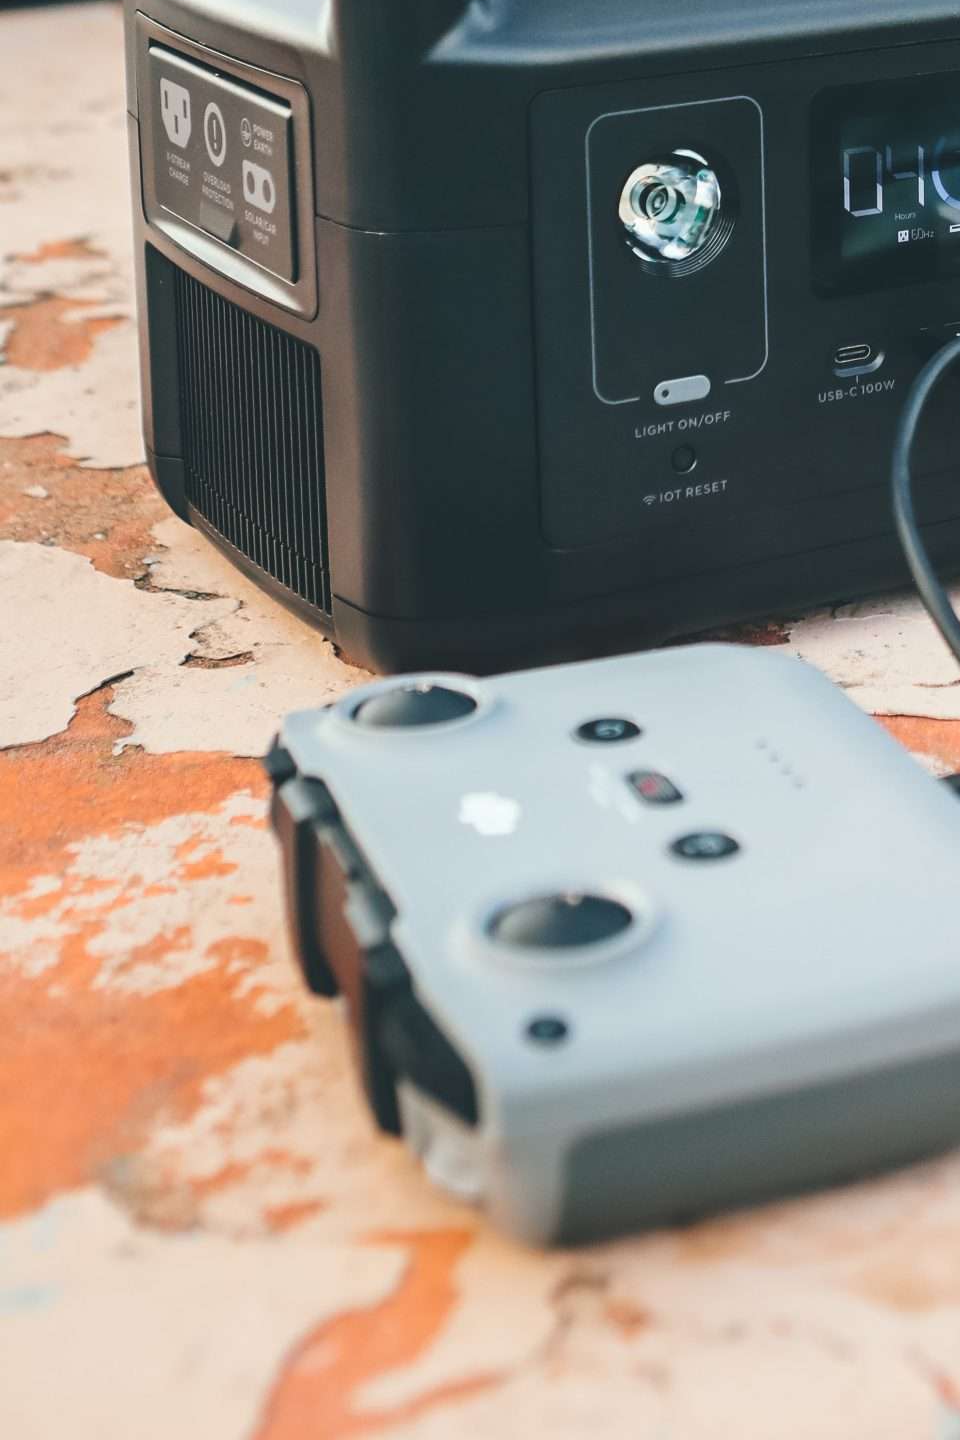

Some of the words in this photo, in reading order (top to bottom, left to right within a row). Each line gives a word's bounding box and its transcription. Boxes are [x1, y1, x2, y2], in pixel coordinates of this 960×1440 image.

[252, 122, 273, 142] POWER
[253, 139, 273, 158] EARTH
[202, 170, 232, 194] OVERLOAD
[842, 145, 925, 218] 04
[202, 184, 235, 211] PROTECTION
[818, 386, 858, 403] USB-C
[861, 379, 895, 395] 100W
[634, 421, 675, 439] LIGHT
[677, 410, 731, 430] ON/OFF
[659, 489, 682, 503] IOT
[685, 479, 728, 498] RESET
